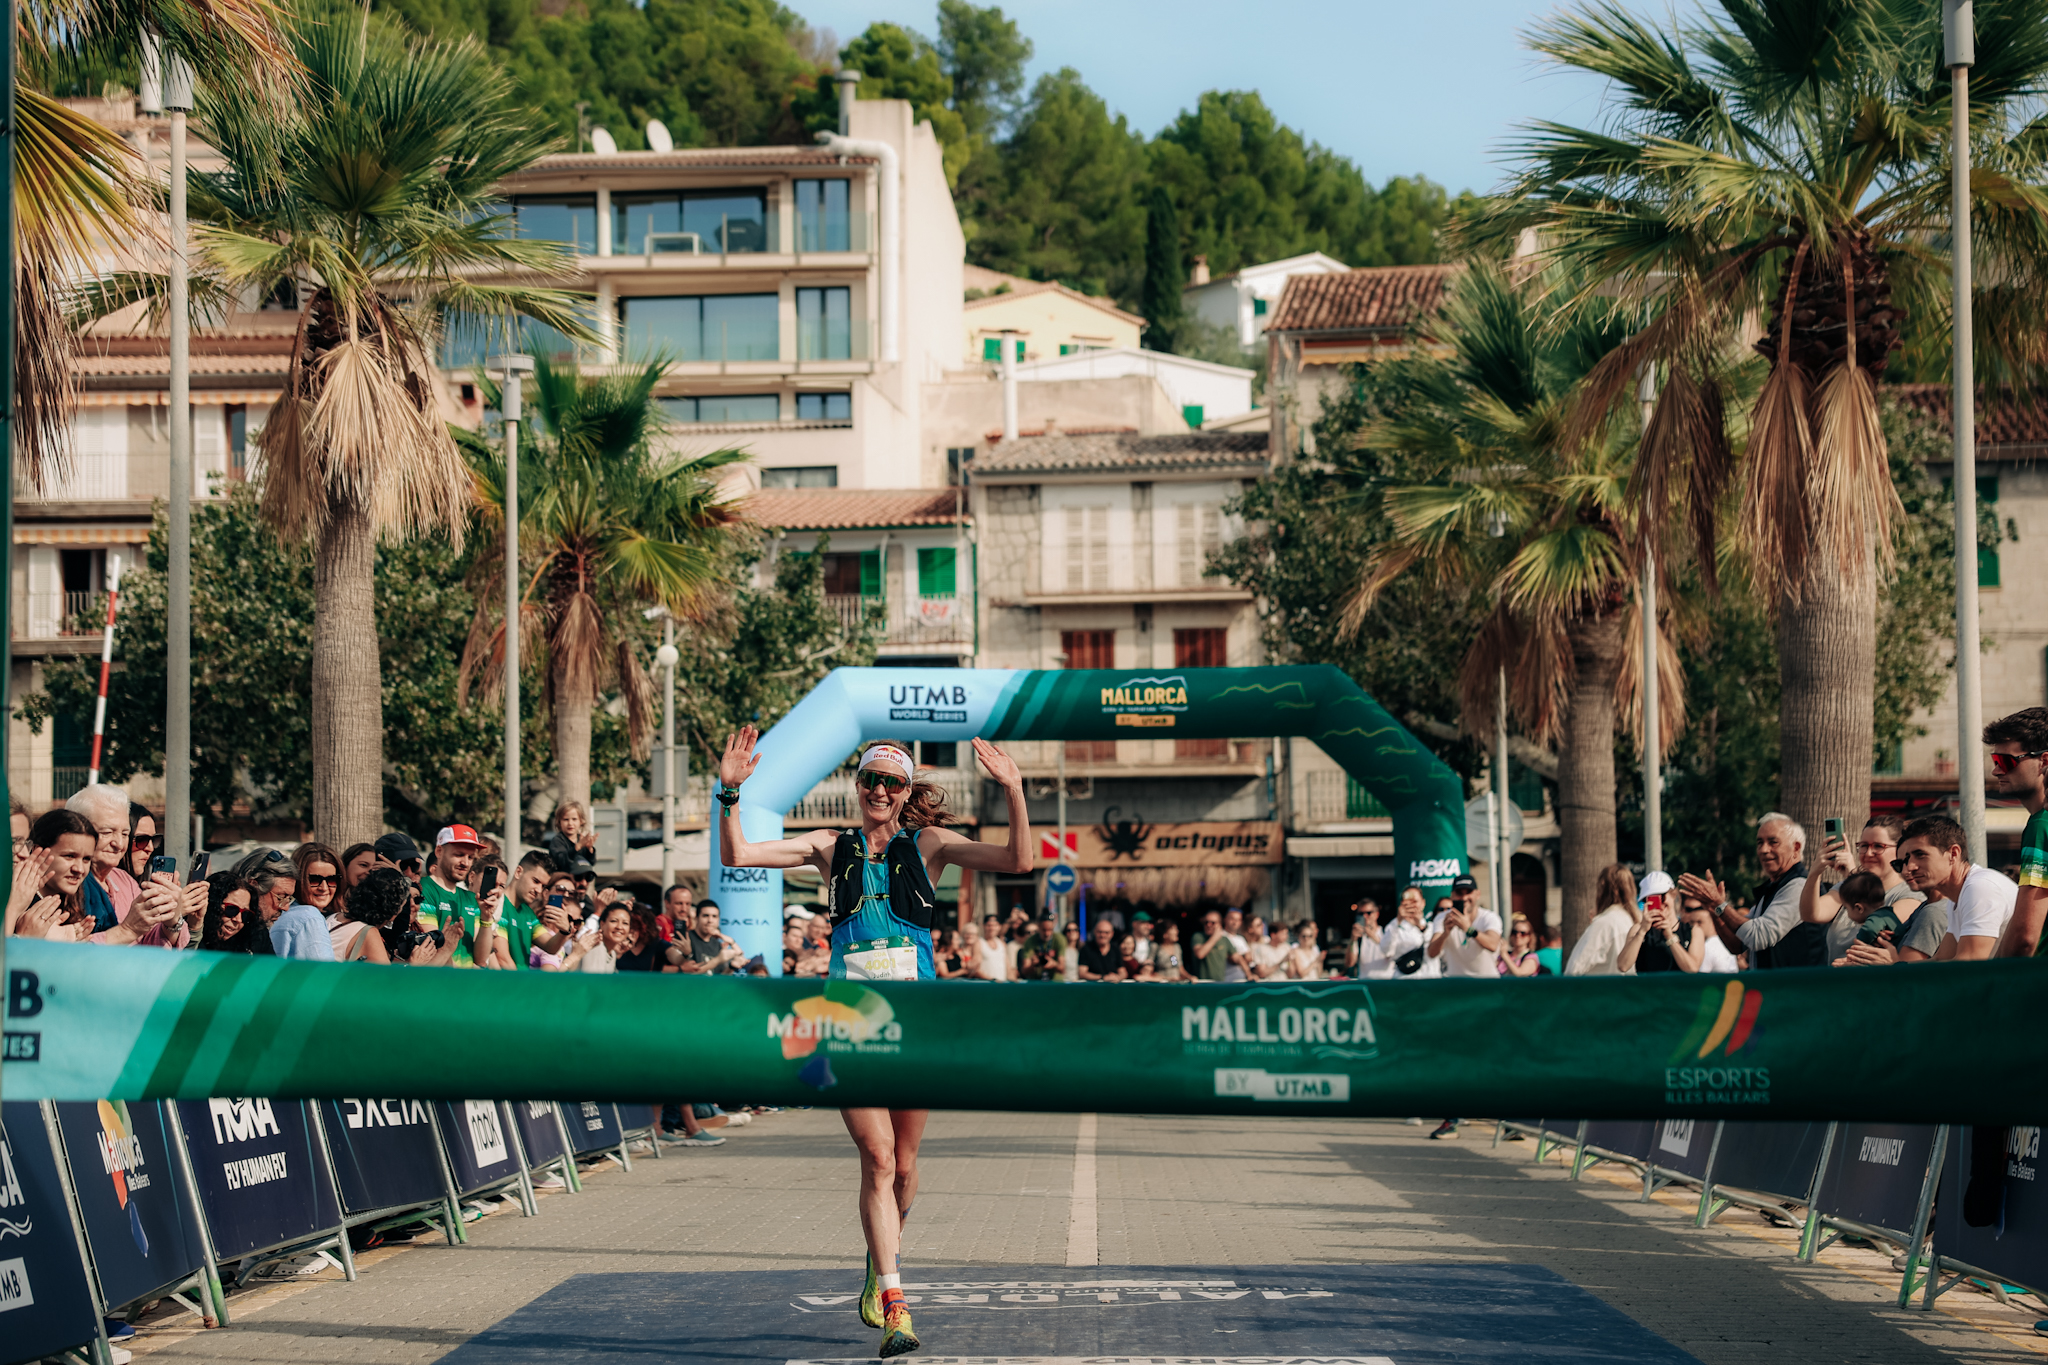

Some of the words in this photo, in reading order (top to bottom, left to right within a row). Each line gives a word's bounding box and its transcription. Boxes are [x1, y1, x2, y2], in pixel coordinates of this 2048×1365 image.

[890, 685, 966, 705] UTMB
[1101, 687, 1188, 705] MALLORCA
[891, 709, 931, 719] WORLD
[932, 711, 965, 721] SERIES
[890, 754, 904, 766] Bull
[1155, 832, 1270, 852] octopus
[720, 868, 769, 883] HOKA
[1409, 858, 1461, 878] HOKA
[829, 875, 839, 917] HOKA
[720, 918, 770, 926] DACIA
[864, 958, 896, 971] 4001
[873, 971, 891, 979] Judith
[767, 1012, 902, 1041] Mallorca
[1181, 1006, 1377, 1043] MALLORCA
[1225, 1072, 1249, 1091] BY
[1274, 1080, 1332, 1096] UTMB
[1665, 1067, 1771, 1089] ESPORTS
[208, 1097, 281, 1145] HOKA
[96, 1129, 145, 1175] Mallorca
[1858, 1136, 1873, 1161] FLY
[1889, 1139, 1905, 1166] FLY
[223, 1161, 242, 1190] FLY
[238, 1155, 275, 1187] HUMAN
[270, 1152, 287, 1179] FLY
